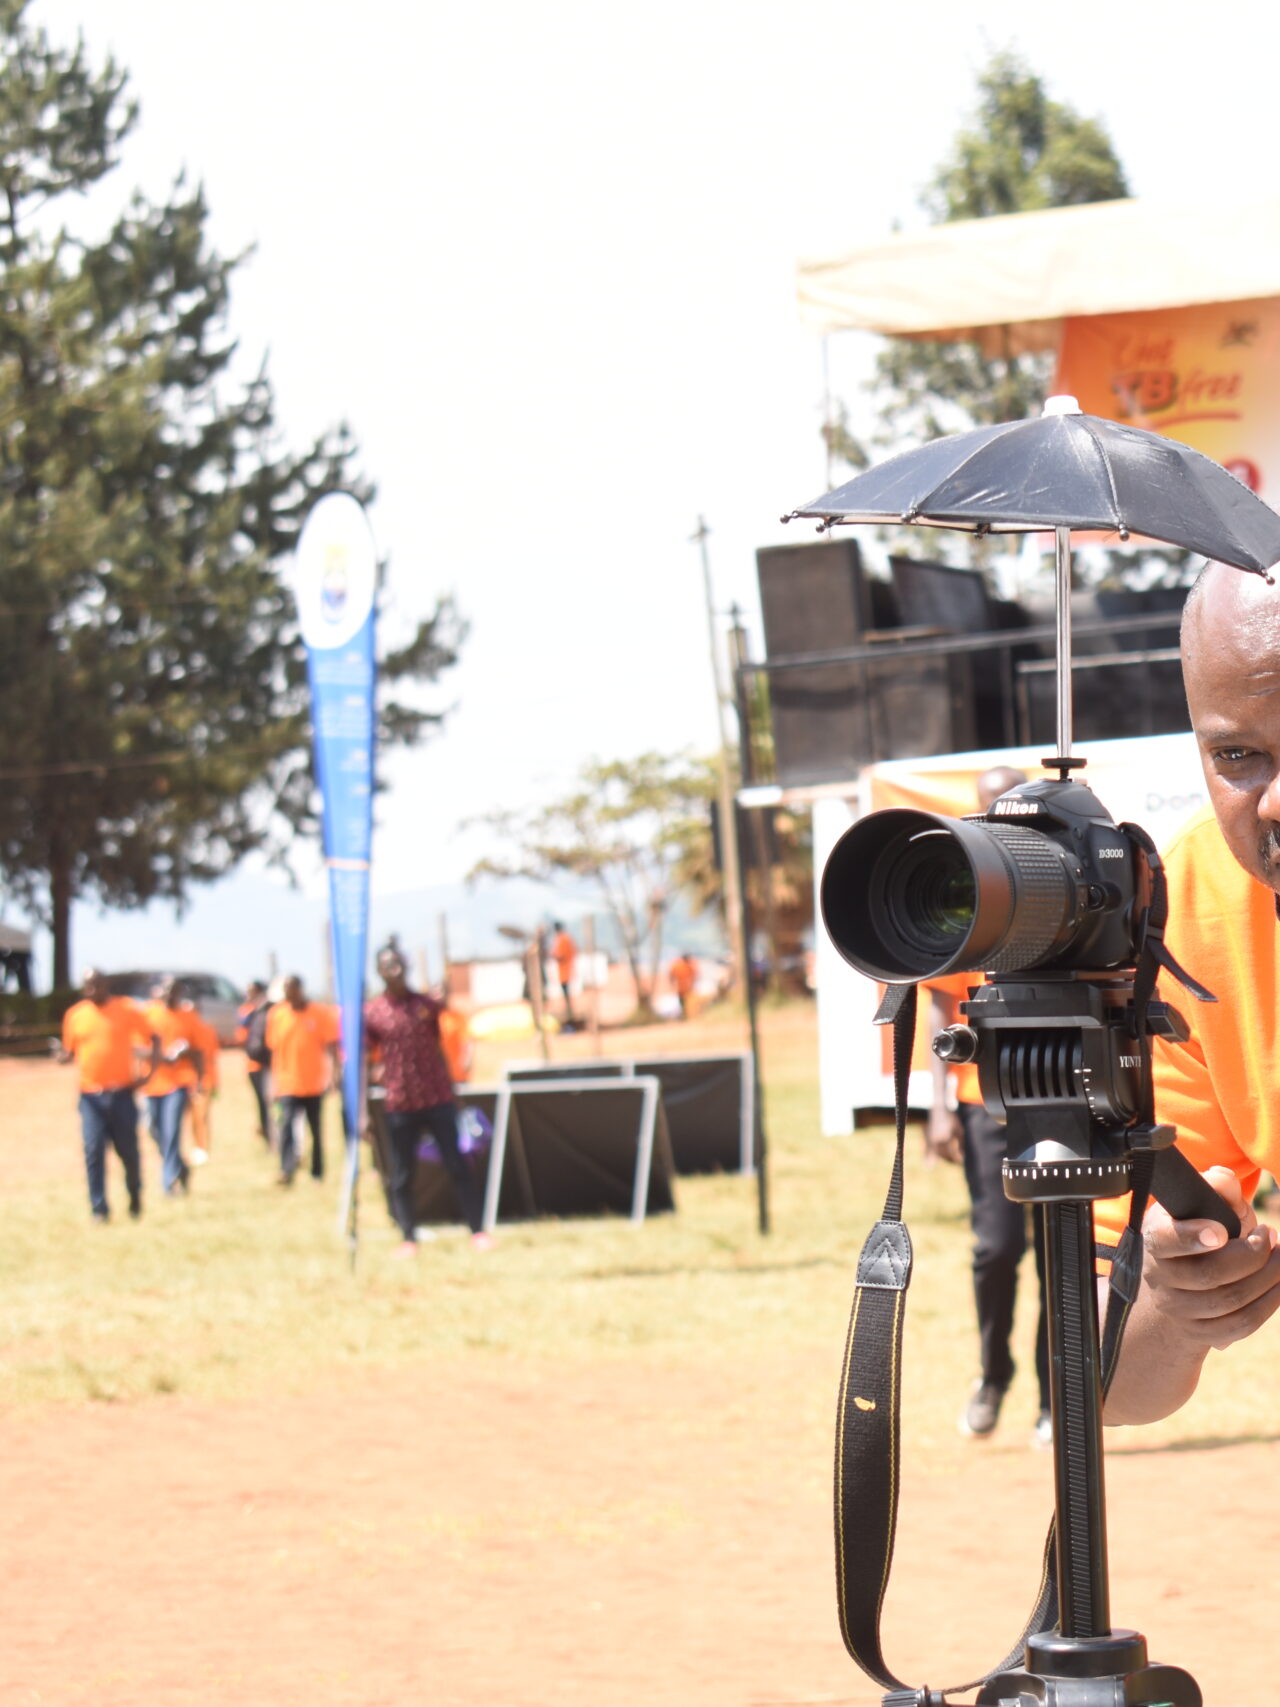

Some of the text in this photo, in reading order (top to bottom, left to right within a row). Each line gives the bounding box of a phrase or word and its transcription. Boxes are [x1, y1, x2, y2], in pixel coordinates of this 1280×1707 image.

[1111, 370, 1179, 418] TB
[995, 801, 1039, 815] Nikon
[1099, 848, 1124, 859] D3000
